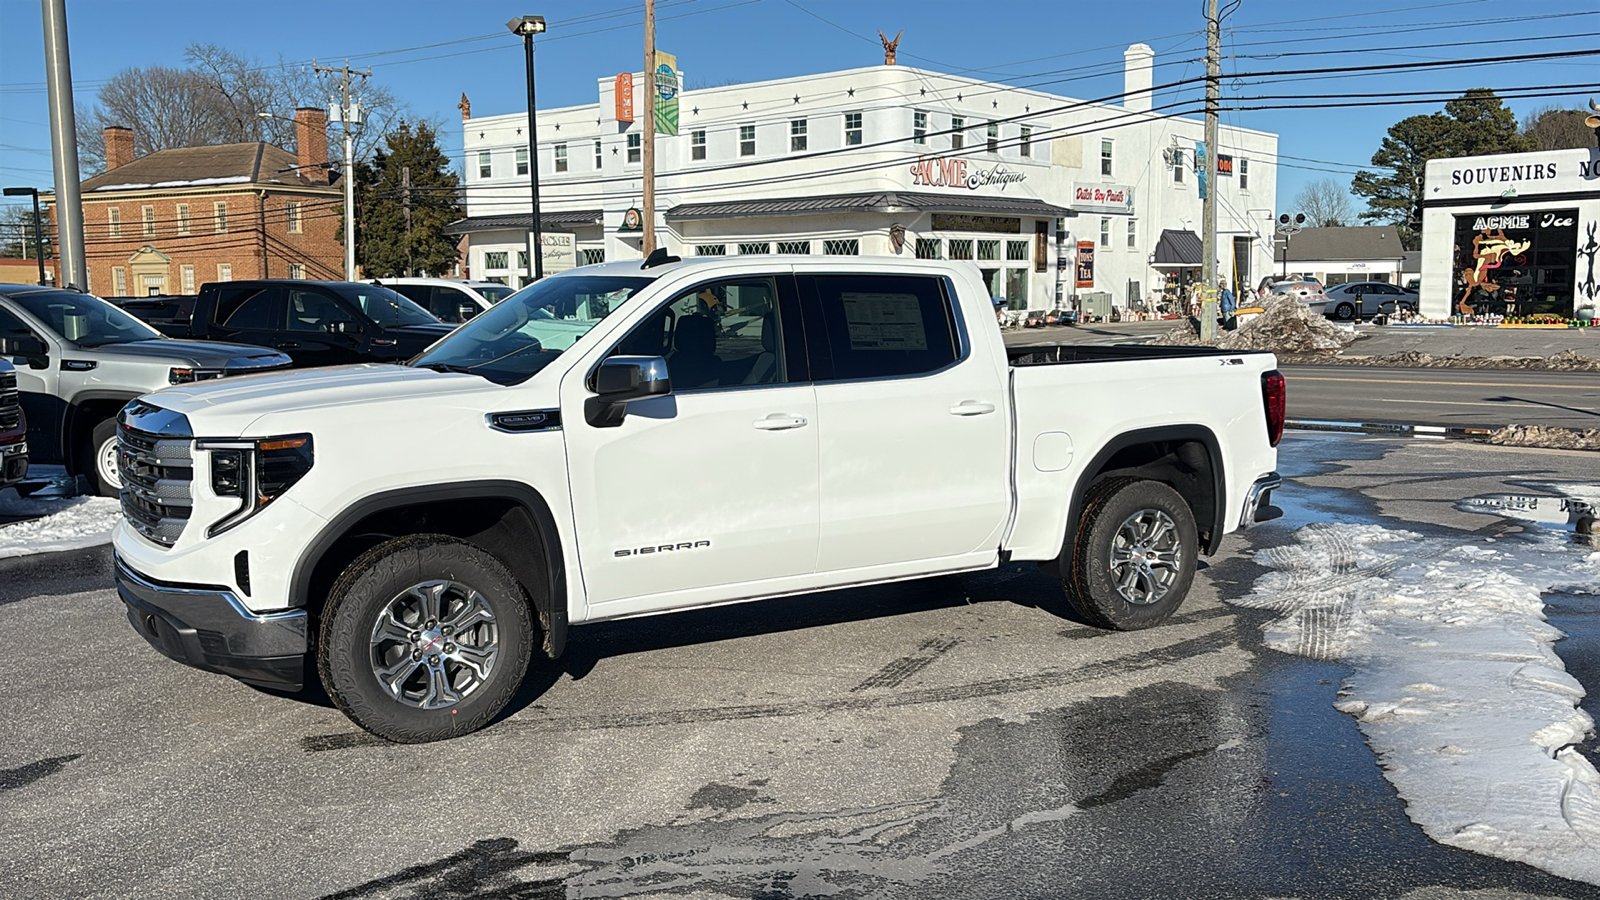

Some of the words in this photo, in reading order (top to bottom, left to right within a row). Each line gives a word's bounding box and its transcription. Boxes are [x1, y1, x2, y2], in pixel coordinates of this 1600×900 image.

[623, 76, 631, 118] ACME
[910, 156, 968, 188] ACME
[967, 163, 1027, 191] Antiques
[1452, 163, 1557, 185] SOUVENIRS
[1076, 187, 1092, 200] Dutch
[1094, 188, 1105, 204] Boy
[1106, 189, 1124, 202] Paints
[1472, 215, 1530, 231] ACME
[1540, 213, 1575, 228] Ice
[541, 235, 571, 247] ACME
[1079, 267, 1092, 279] TEA
[614, 540, 711, 558] SIERRA
